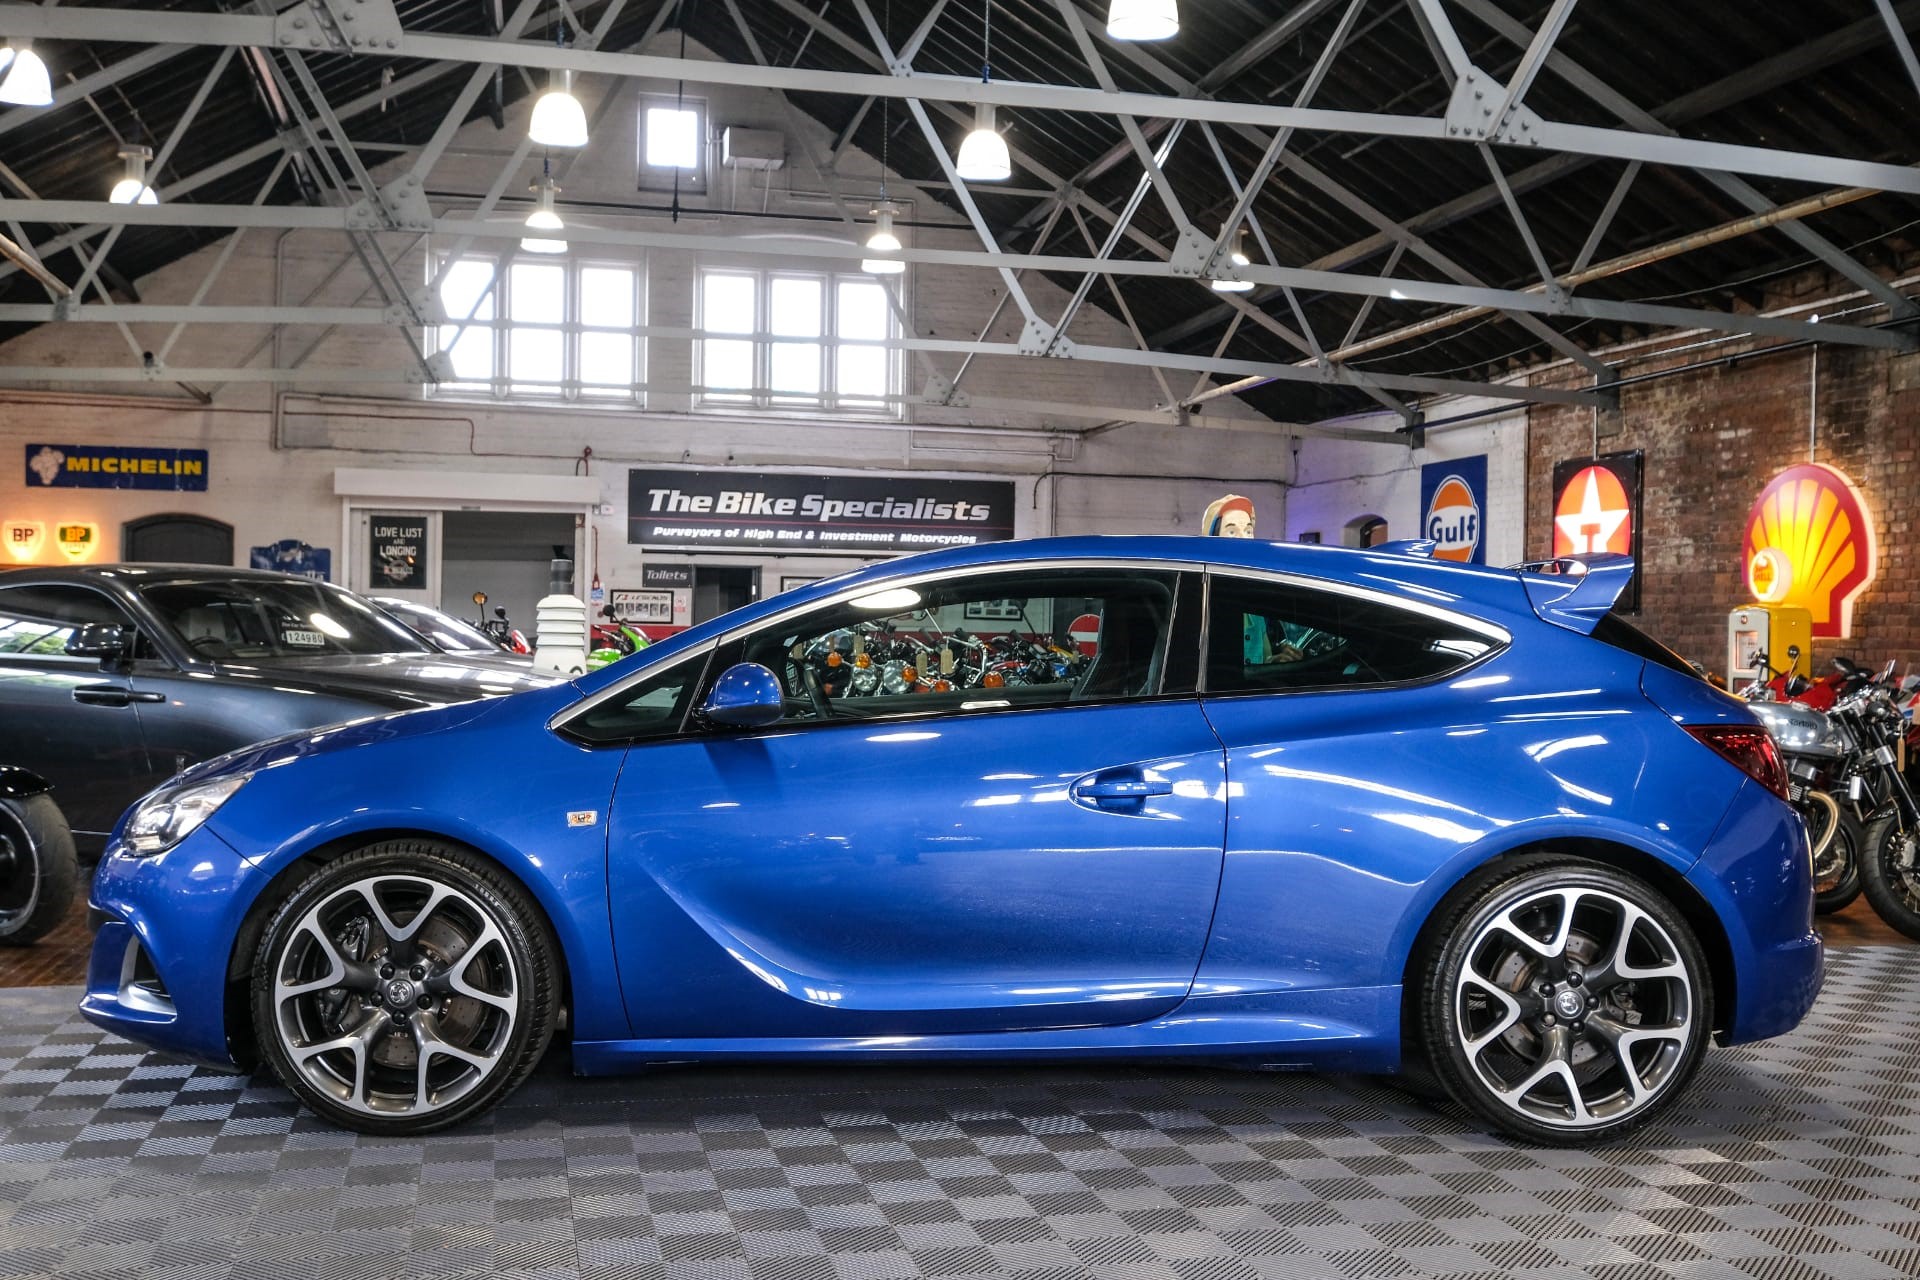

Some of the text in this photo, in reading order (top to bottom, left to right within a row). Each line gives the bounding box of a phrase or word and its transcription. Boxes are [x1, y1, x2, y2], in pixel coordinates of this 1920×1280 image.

[66, 457, 202, 475] MICHELIN
[648, 489, 990, 522] The Bike Specialists
[13, 528, 34, 542] BP
[65, 528, 87, 542] BP
[374, 527, 423, 538] LOVE LUST
[653, 526, 977, 545] Purveyors of High End & Investment Motorcycles
[1429, 514, 1477, 544] Gulf
[380, 545, 417, 556] LONGING
[647, 569, 688, 580] Toilets
